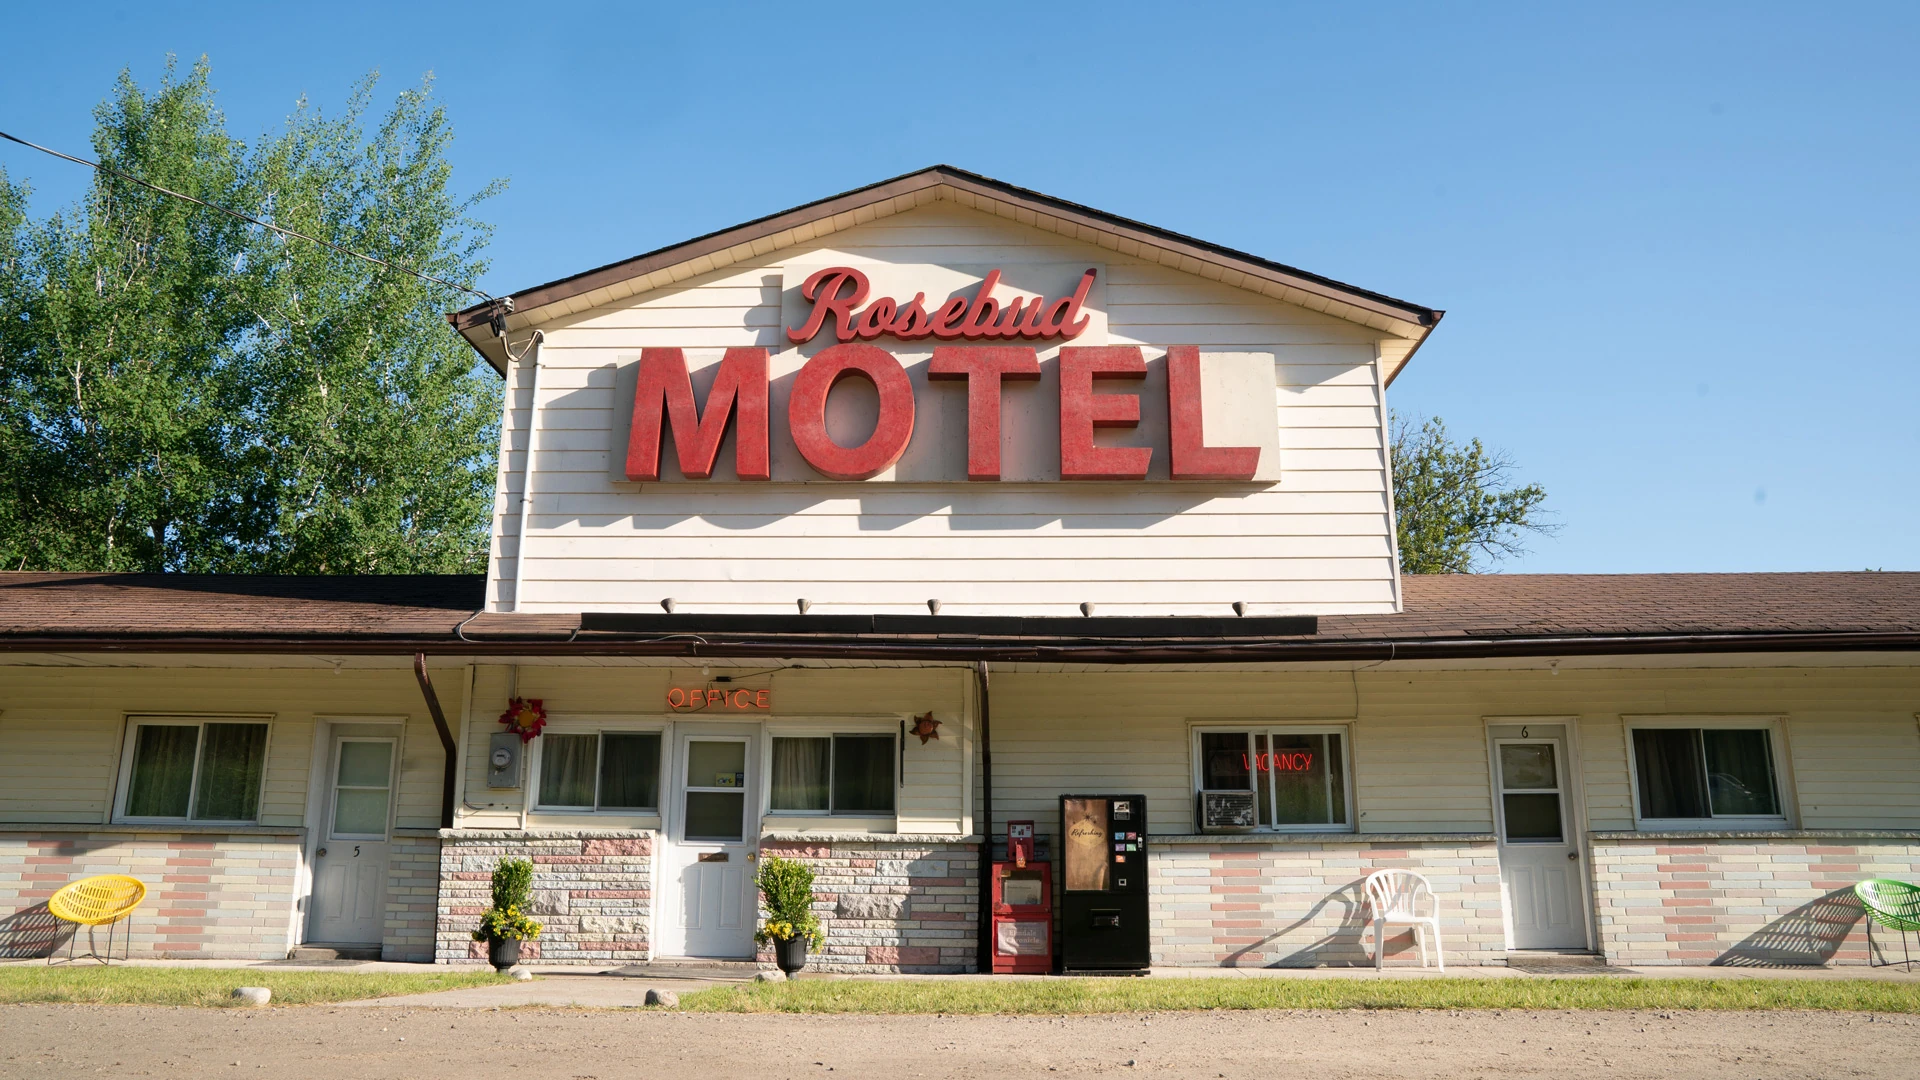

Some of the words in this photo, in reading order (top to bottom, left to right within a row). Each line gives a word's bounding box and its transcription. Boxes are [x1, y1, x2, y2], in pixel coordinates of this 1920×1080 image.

[786, 266, 1098, 344] Rosebud
[624, 343, 1261, 481] MOTEL
[668, 688, 769, 708] OFFICE
[1521, 726, 1528, 738] 6
[1242, 753, 1312, 771] VACANCY
[1070, 828, 1103, 838] Refreshing
[353, 846, 360, 857] 5
